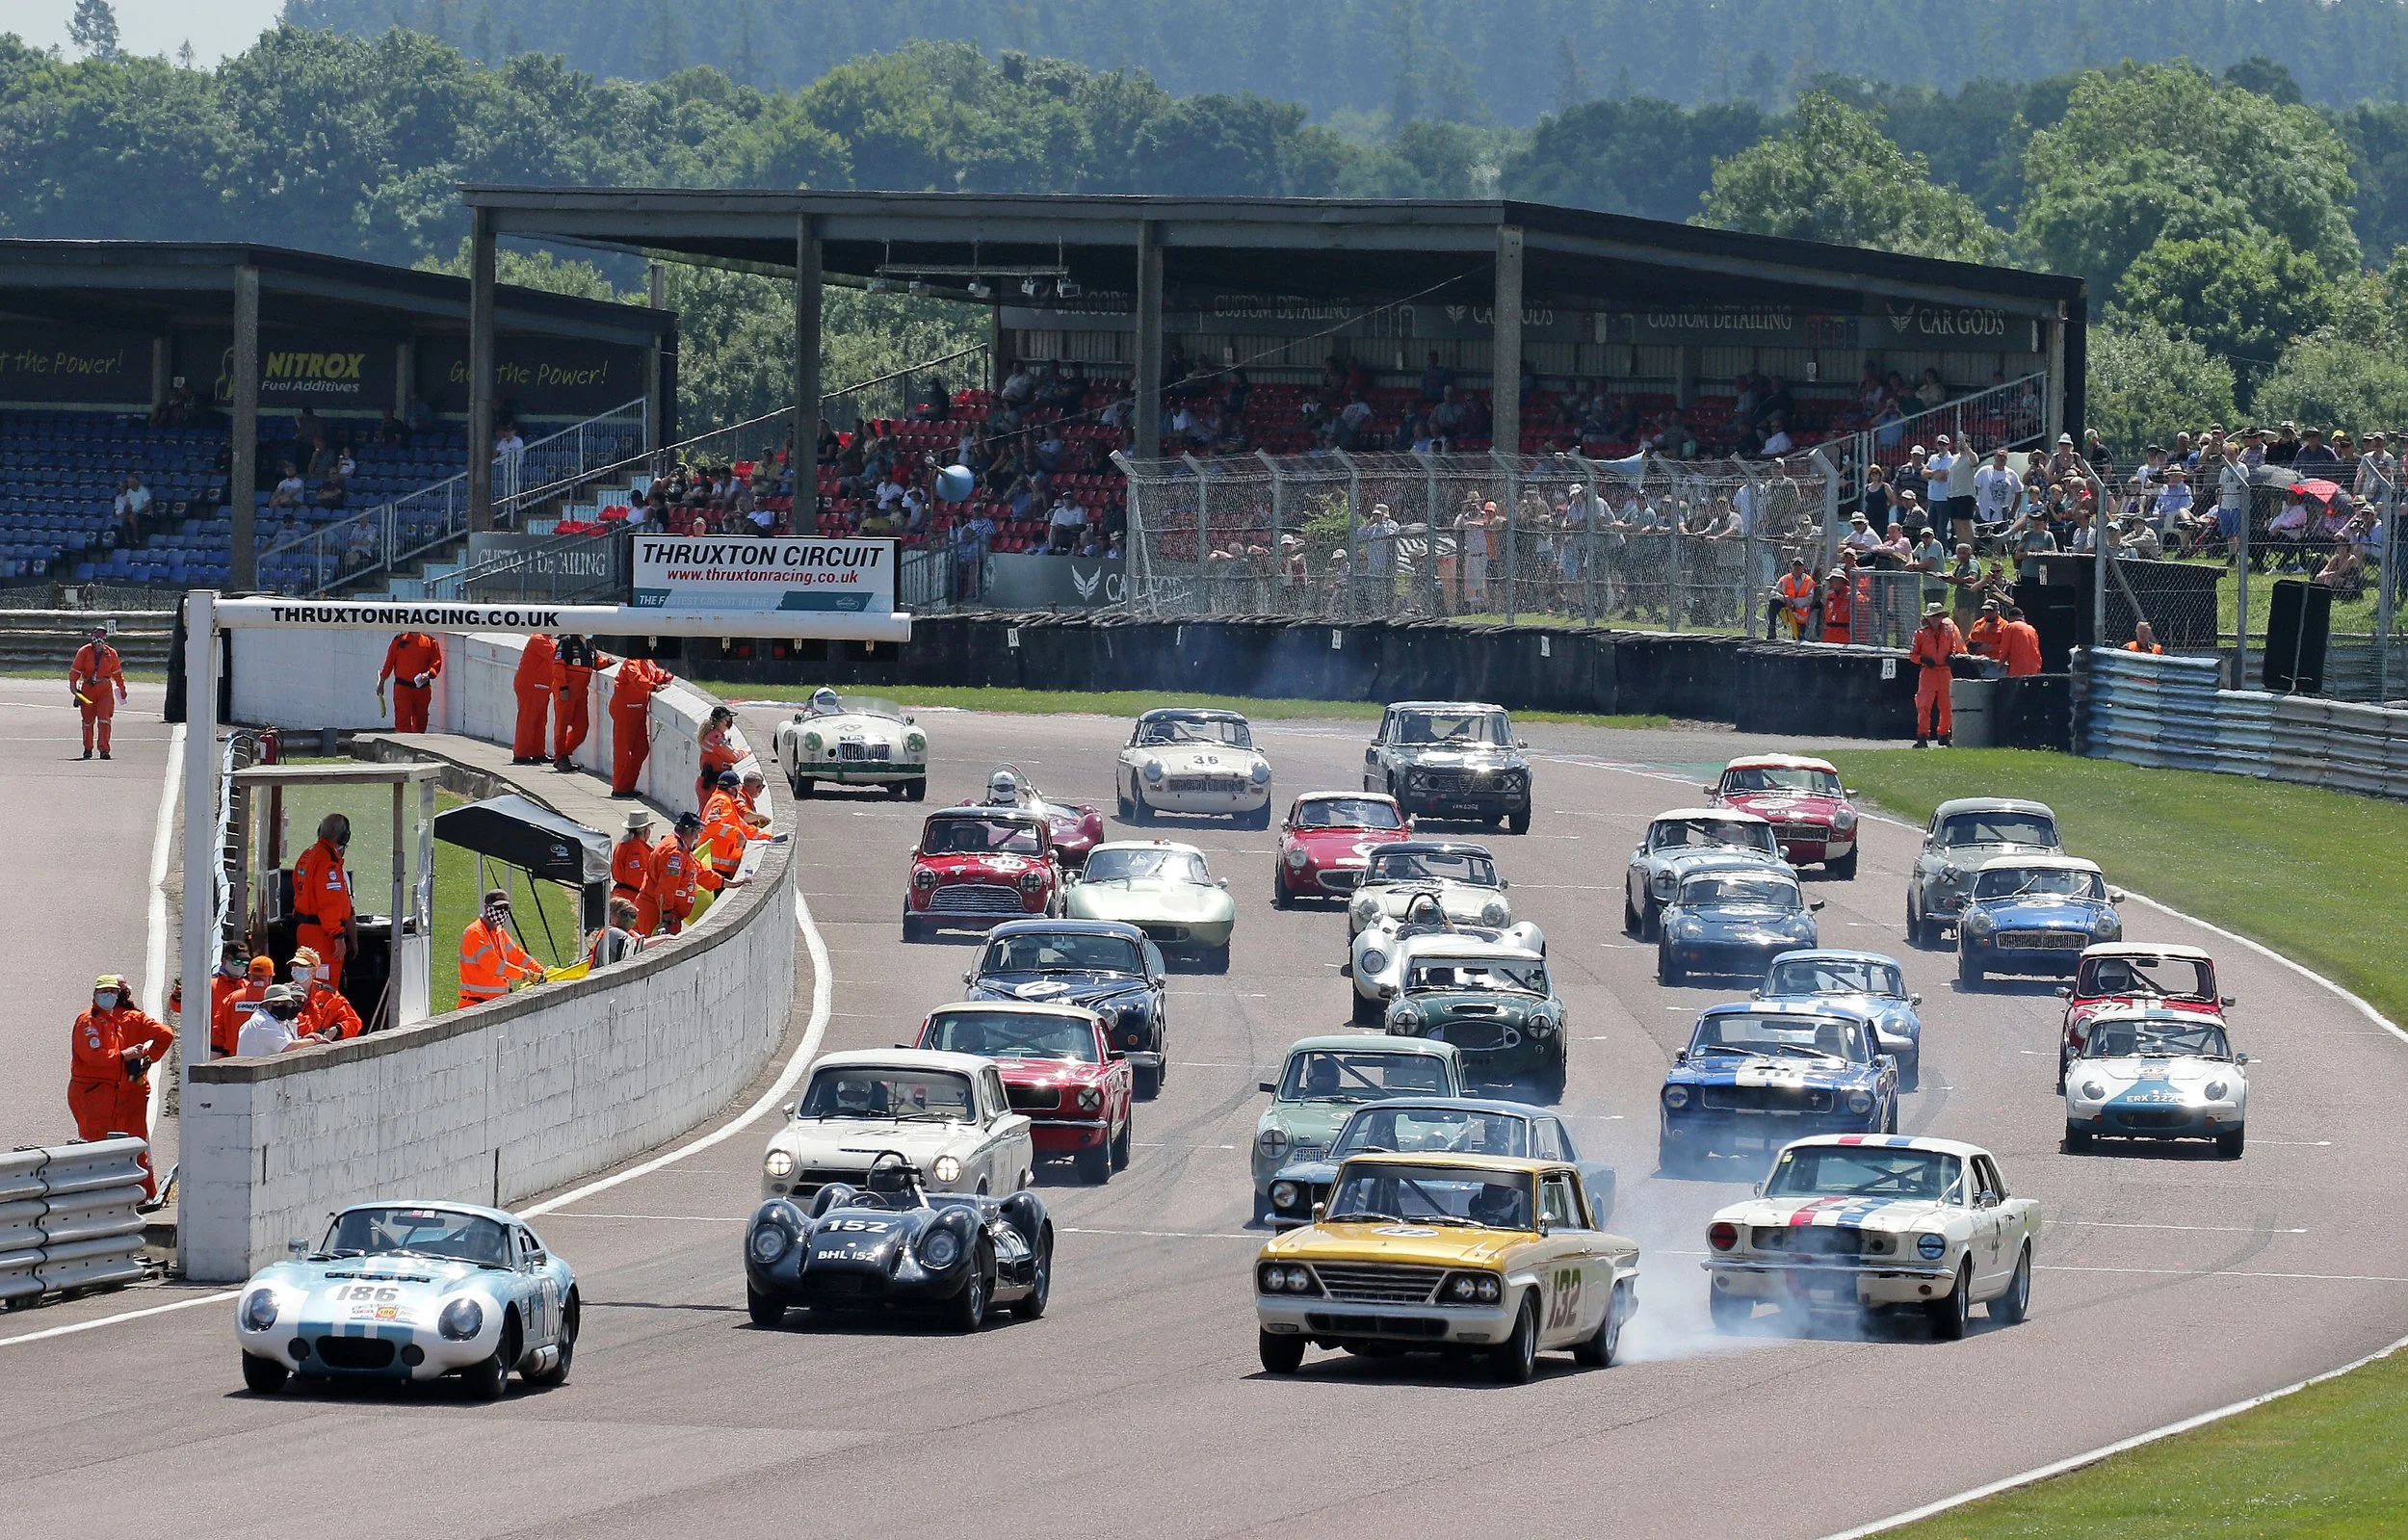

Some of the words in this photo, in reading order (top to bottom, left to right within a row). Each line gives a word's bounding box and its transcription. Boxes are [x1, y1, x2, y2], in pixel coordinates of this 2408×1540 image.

[1088, 291, 1129, 316] GODS
[1215, 295, 1271, 319] CUSTOM
[1276, 295, 1351, 320] DETAILING
[1647, 304, 1710, 328] CUSTOM
[1714, 304, 1793, 330] DETAILING
[1919, 307, 1955, 335] CAR
[1956, 308, 2005, 336] GODS
[15, 349, 49, 374] the
[53, 349, 124, 375] Power!
[265, 352, 366, 378] NITROX
[495, 361, 531, 385] the
[537, 360, 609, 386] Power!
[261, 379, 290, 392] Fuel
[292, 379, 361, 393] Additives
[641, 542, 778, 566] THRUXTON
[782, 544, 885, 567] CIRCUIT
[667, 567, 859, 587] www.thruxtonracing.co.uk
[639, 594, 657, 605] THE
[271, 607, 559, 628] THRUXTONRACING.CO.UK
[1192, 755, 1219, 765] 36
[2126, 1094, 2149, 1103] ERX
[827, 1219, 888, 1234] 152
[817, 1250, 849, 1260] BHL
[851, 1251, 877, 1263] 152
[336, 1286, 400, 1302] 186
[1546, 1267, 1582, 1330] 132
